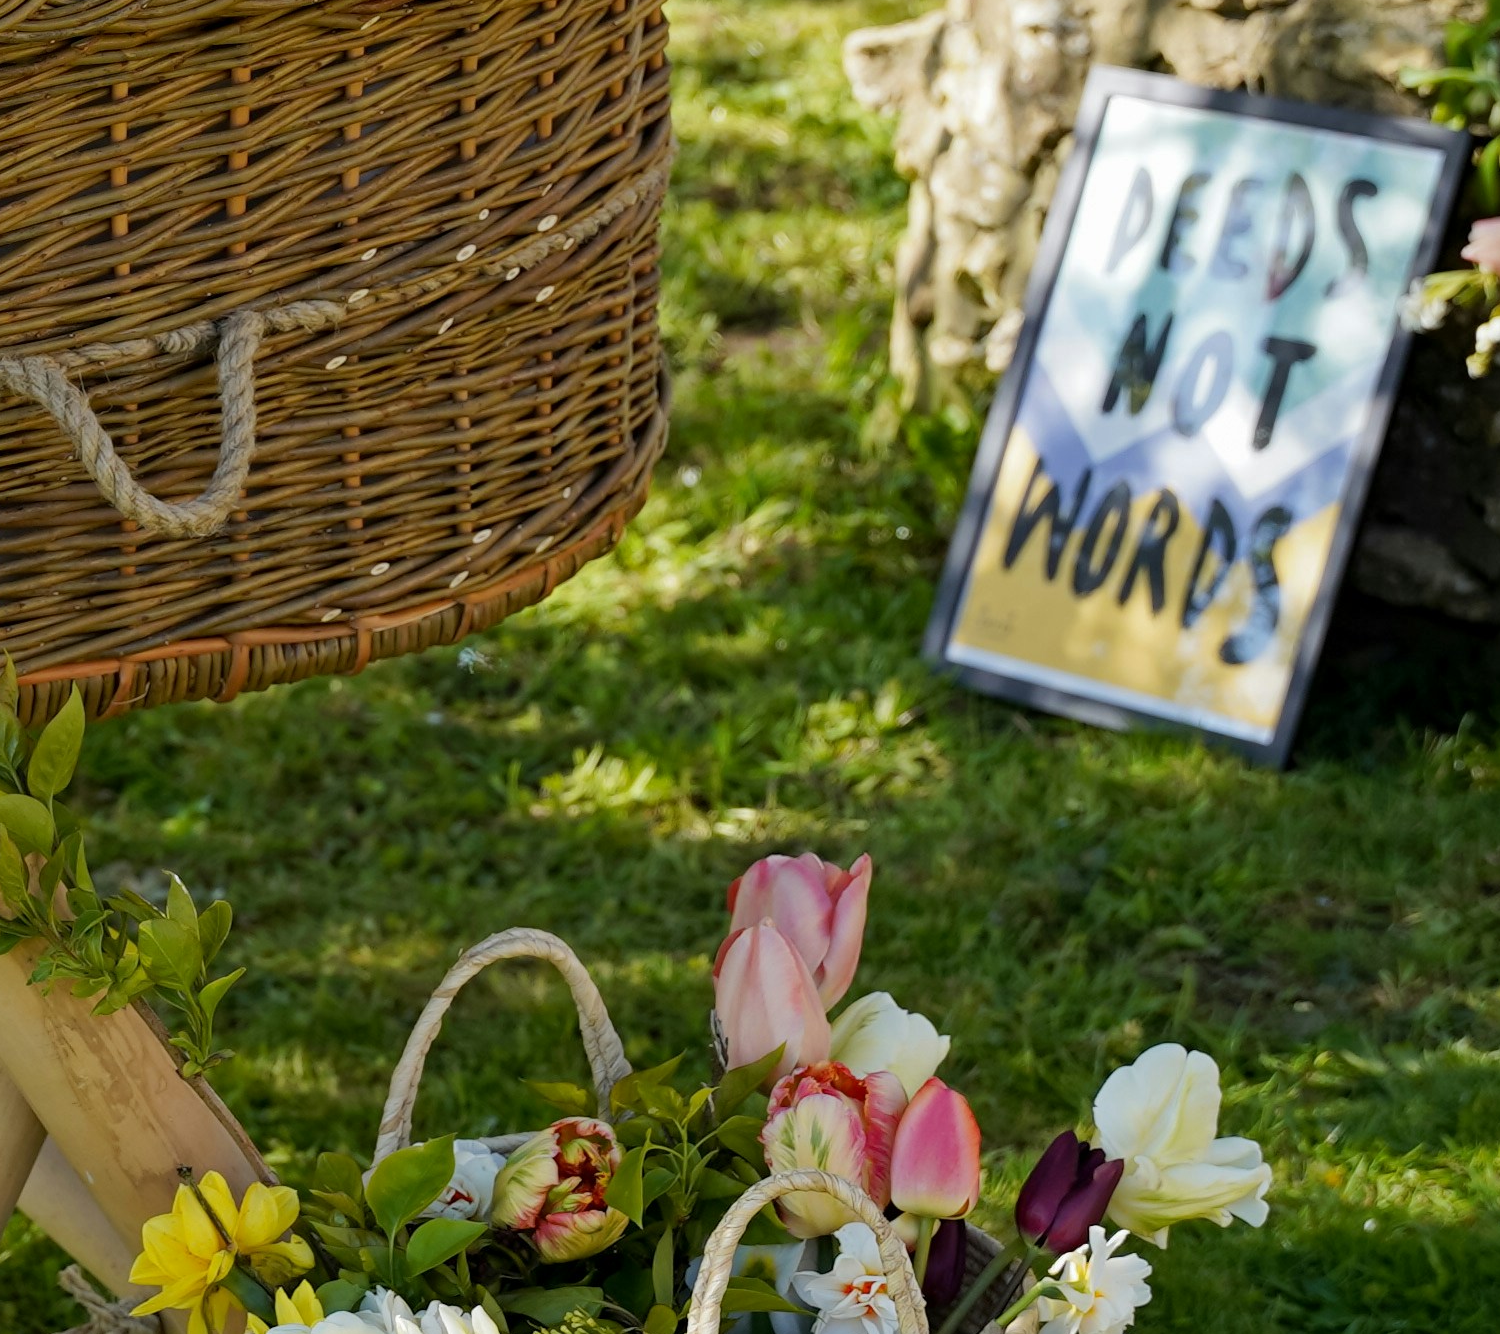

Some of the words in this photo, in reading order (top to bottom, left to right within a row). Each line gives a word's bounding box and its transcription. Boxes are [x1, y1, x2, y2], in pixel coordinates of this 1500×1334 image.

[1107, 166, 1379, 303] DEEDS
[1101, 311, 1317, 452] NOT
[1003, 457, 1294, 665] WORDS
